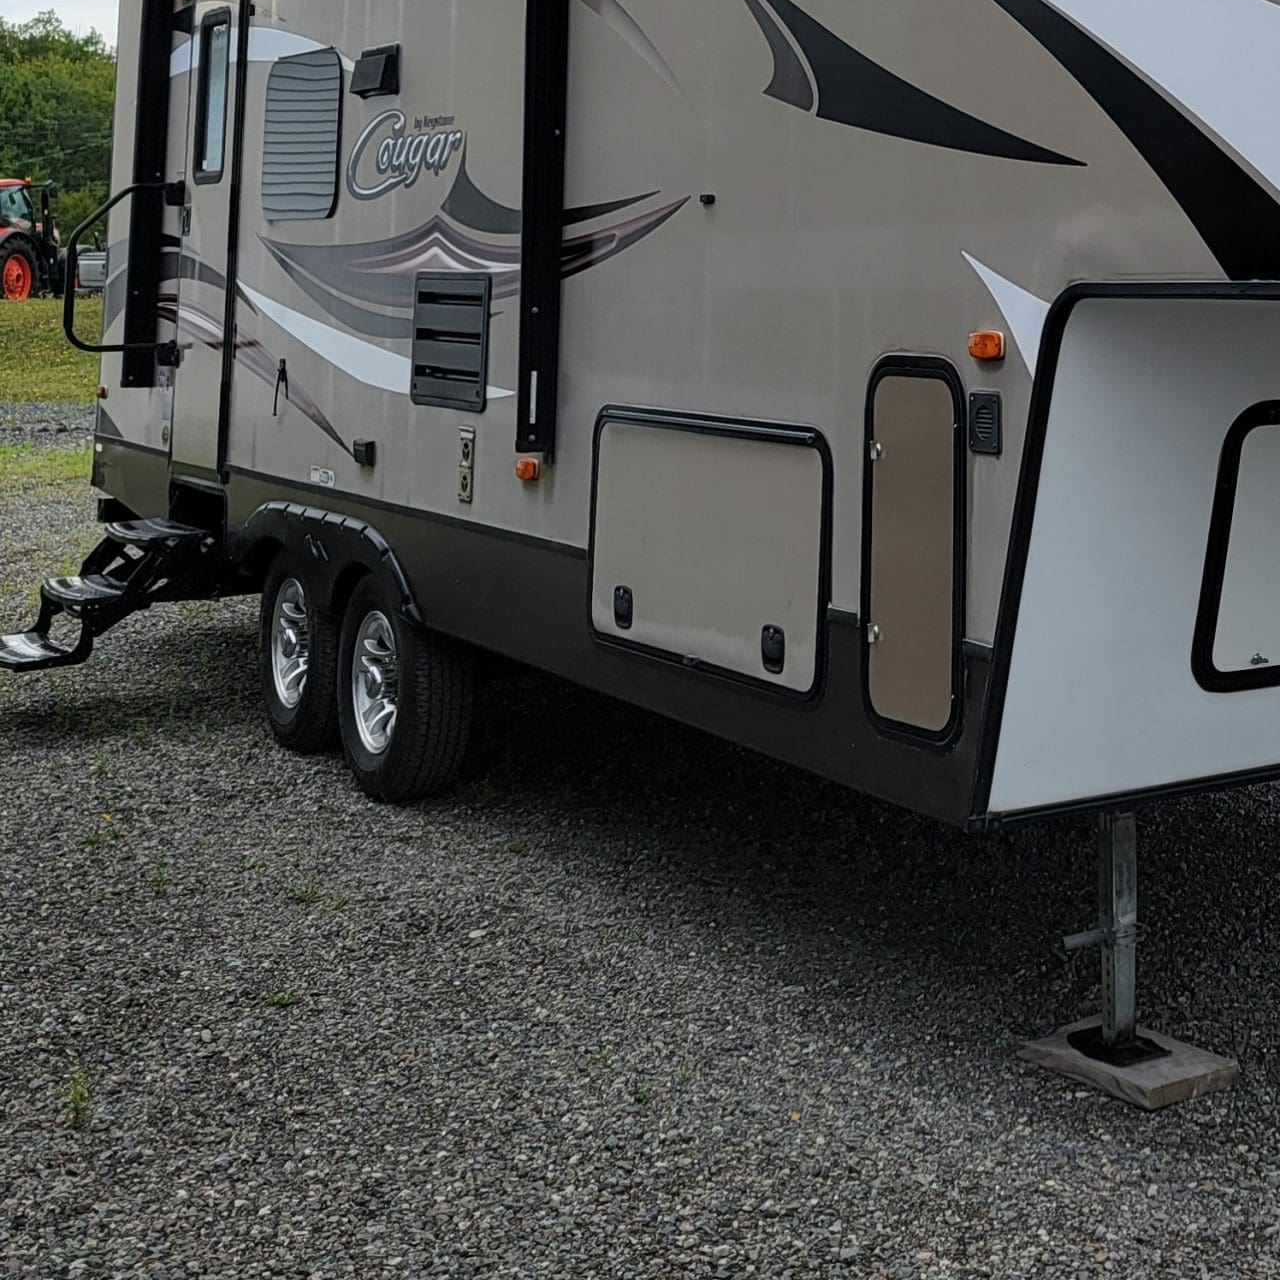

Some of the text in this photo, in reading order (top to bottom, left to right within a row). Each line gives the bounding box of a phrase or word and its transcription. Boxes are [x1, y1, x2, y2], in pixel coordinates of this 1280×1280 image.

[413, 115, 456, 131] by Keystone
[346, 109, 462, 200] Cougar
